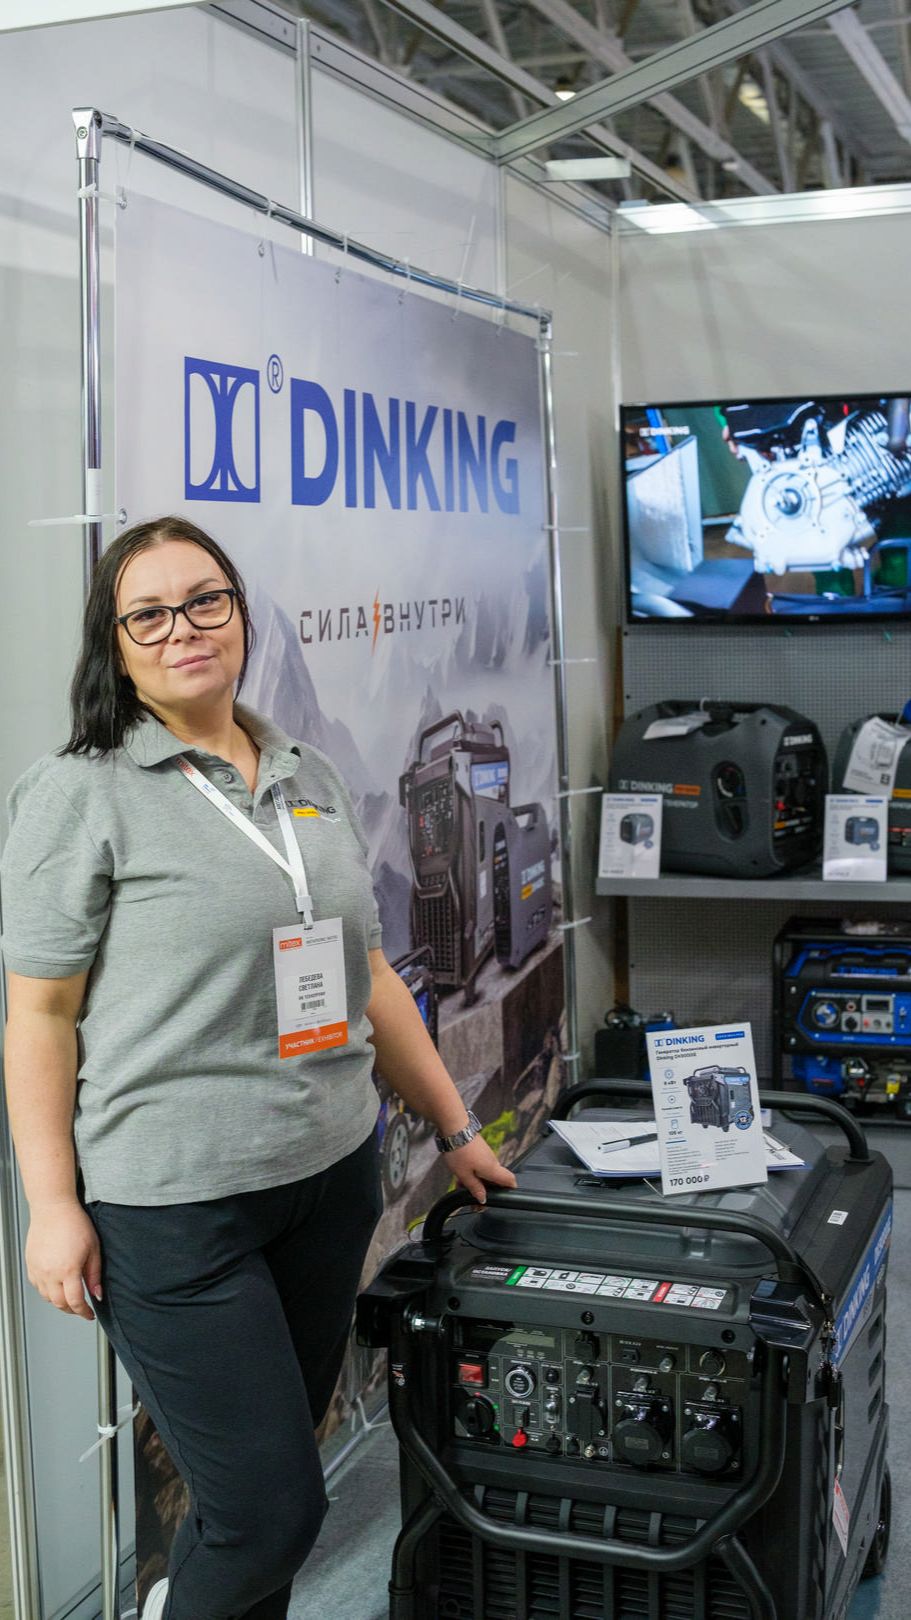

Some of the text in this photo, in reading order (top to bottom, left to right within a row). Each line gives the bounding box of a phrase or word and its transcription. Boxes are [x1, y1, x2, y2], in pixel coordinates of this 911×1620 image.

[290, 377, 520, 515] DINKING
[299, 596, 467, 645] СИЛА ВНУТРИ
[630, 781, 674, 794] DINKING
[299, 973, 323, 983] ЛЕБЕДЕВА
[298, 982, 323, 992] СВЕТЛАНА
[665, 1035, 705, 1046] DINKING
[669, 1178, 684, 1187] 170
[685, 1175, 703, 1184] 000
